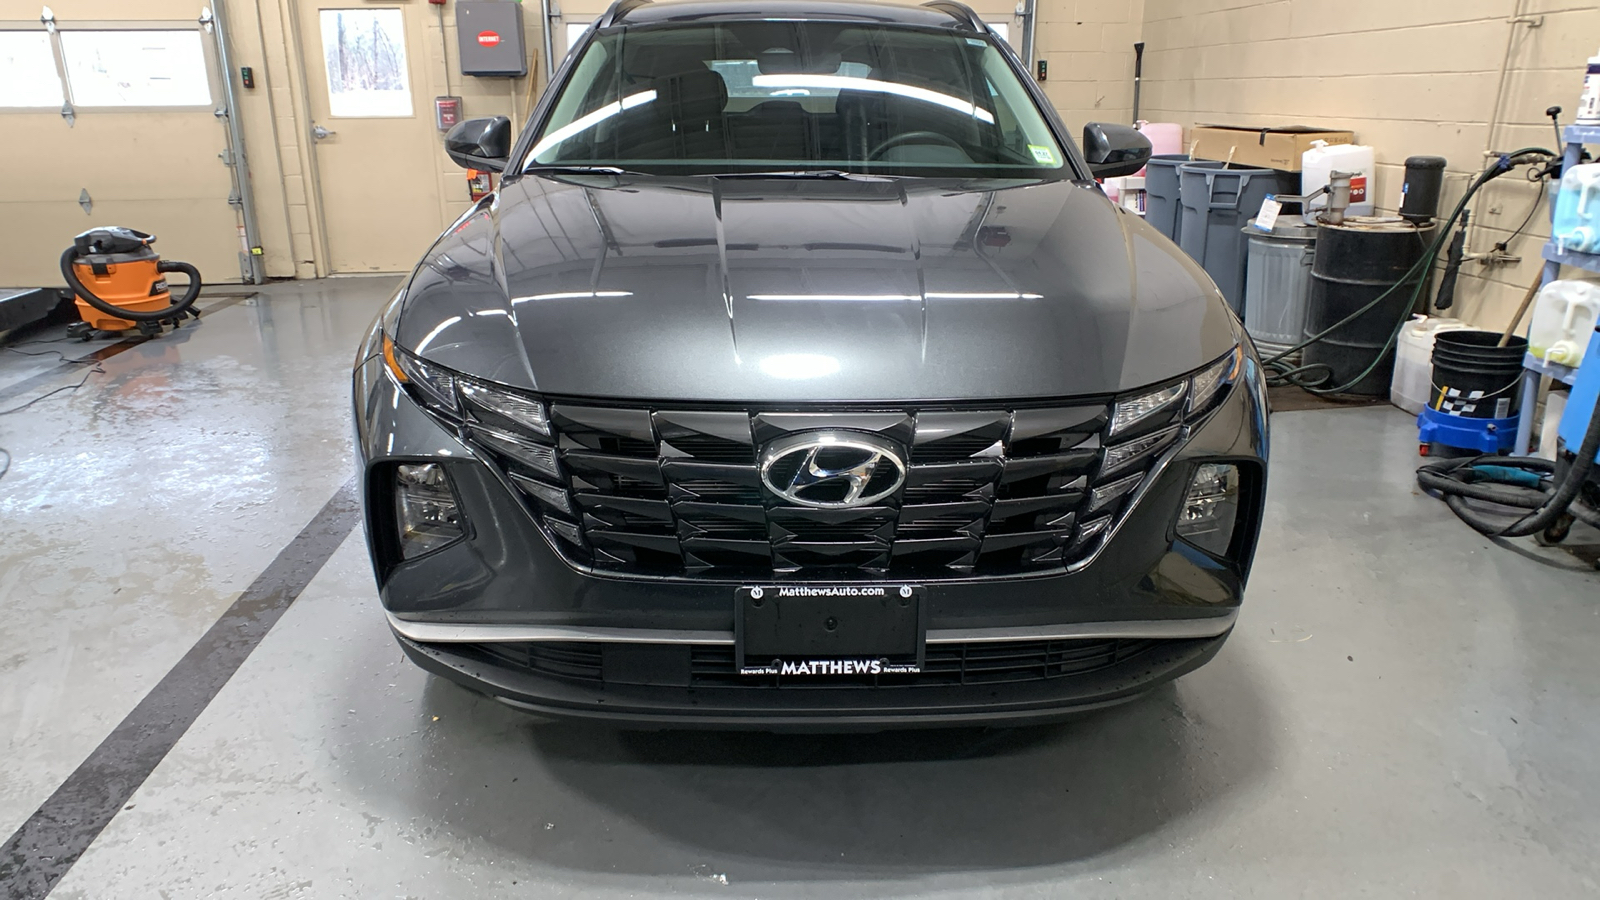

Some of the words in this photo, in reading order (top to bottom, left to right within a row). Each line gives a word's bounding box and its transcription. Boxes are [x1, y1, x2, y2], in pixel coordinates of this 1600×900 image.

[779, 586, 885, 597] MatthewsAuto.com
[765, 667, 778, 675] Plus
[780, 660, 881, 675] MATTHEWS
